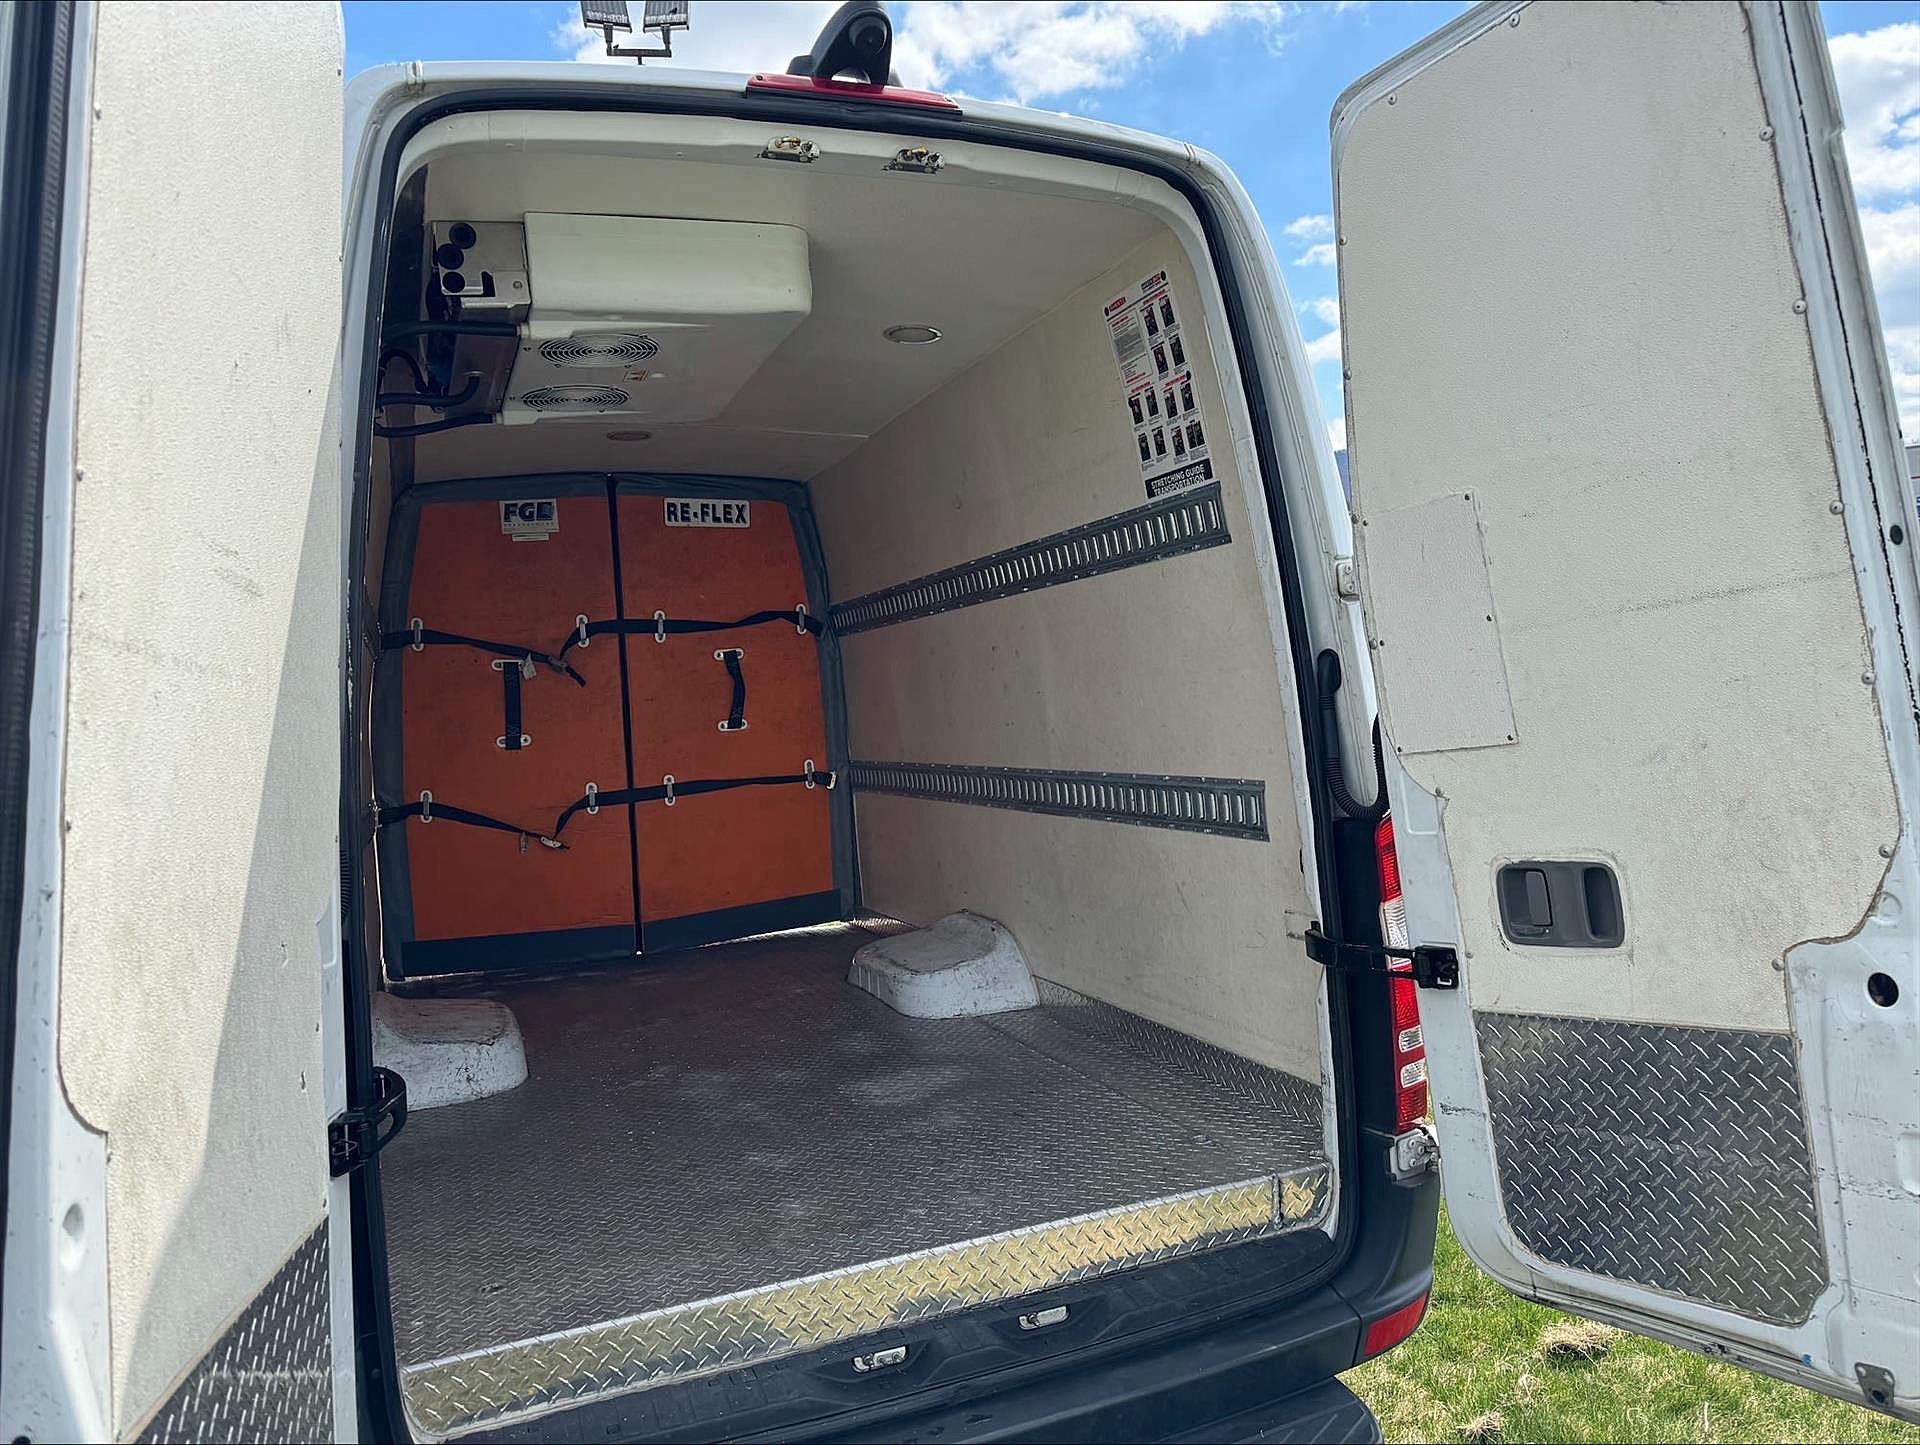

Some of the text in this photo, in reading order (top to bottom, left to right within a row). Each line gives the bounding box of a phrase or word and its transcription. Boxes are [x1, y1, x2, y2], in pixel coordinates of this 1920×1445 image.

[1151, 464, 1205, 490] STRETCHING GUIDE
[1153, 473, 1205, 497] TRANSPORTATION
